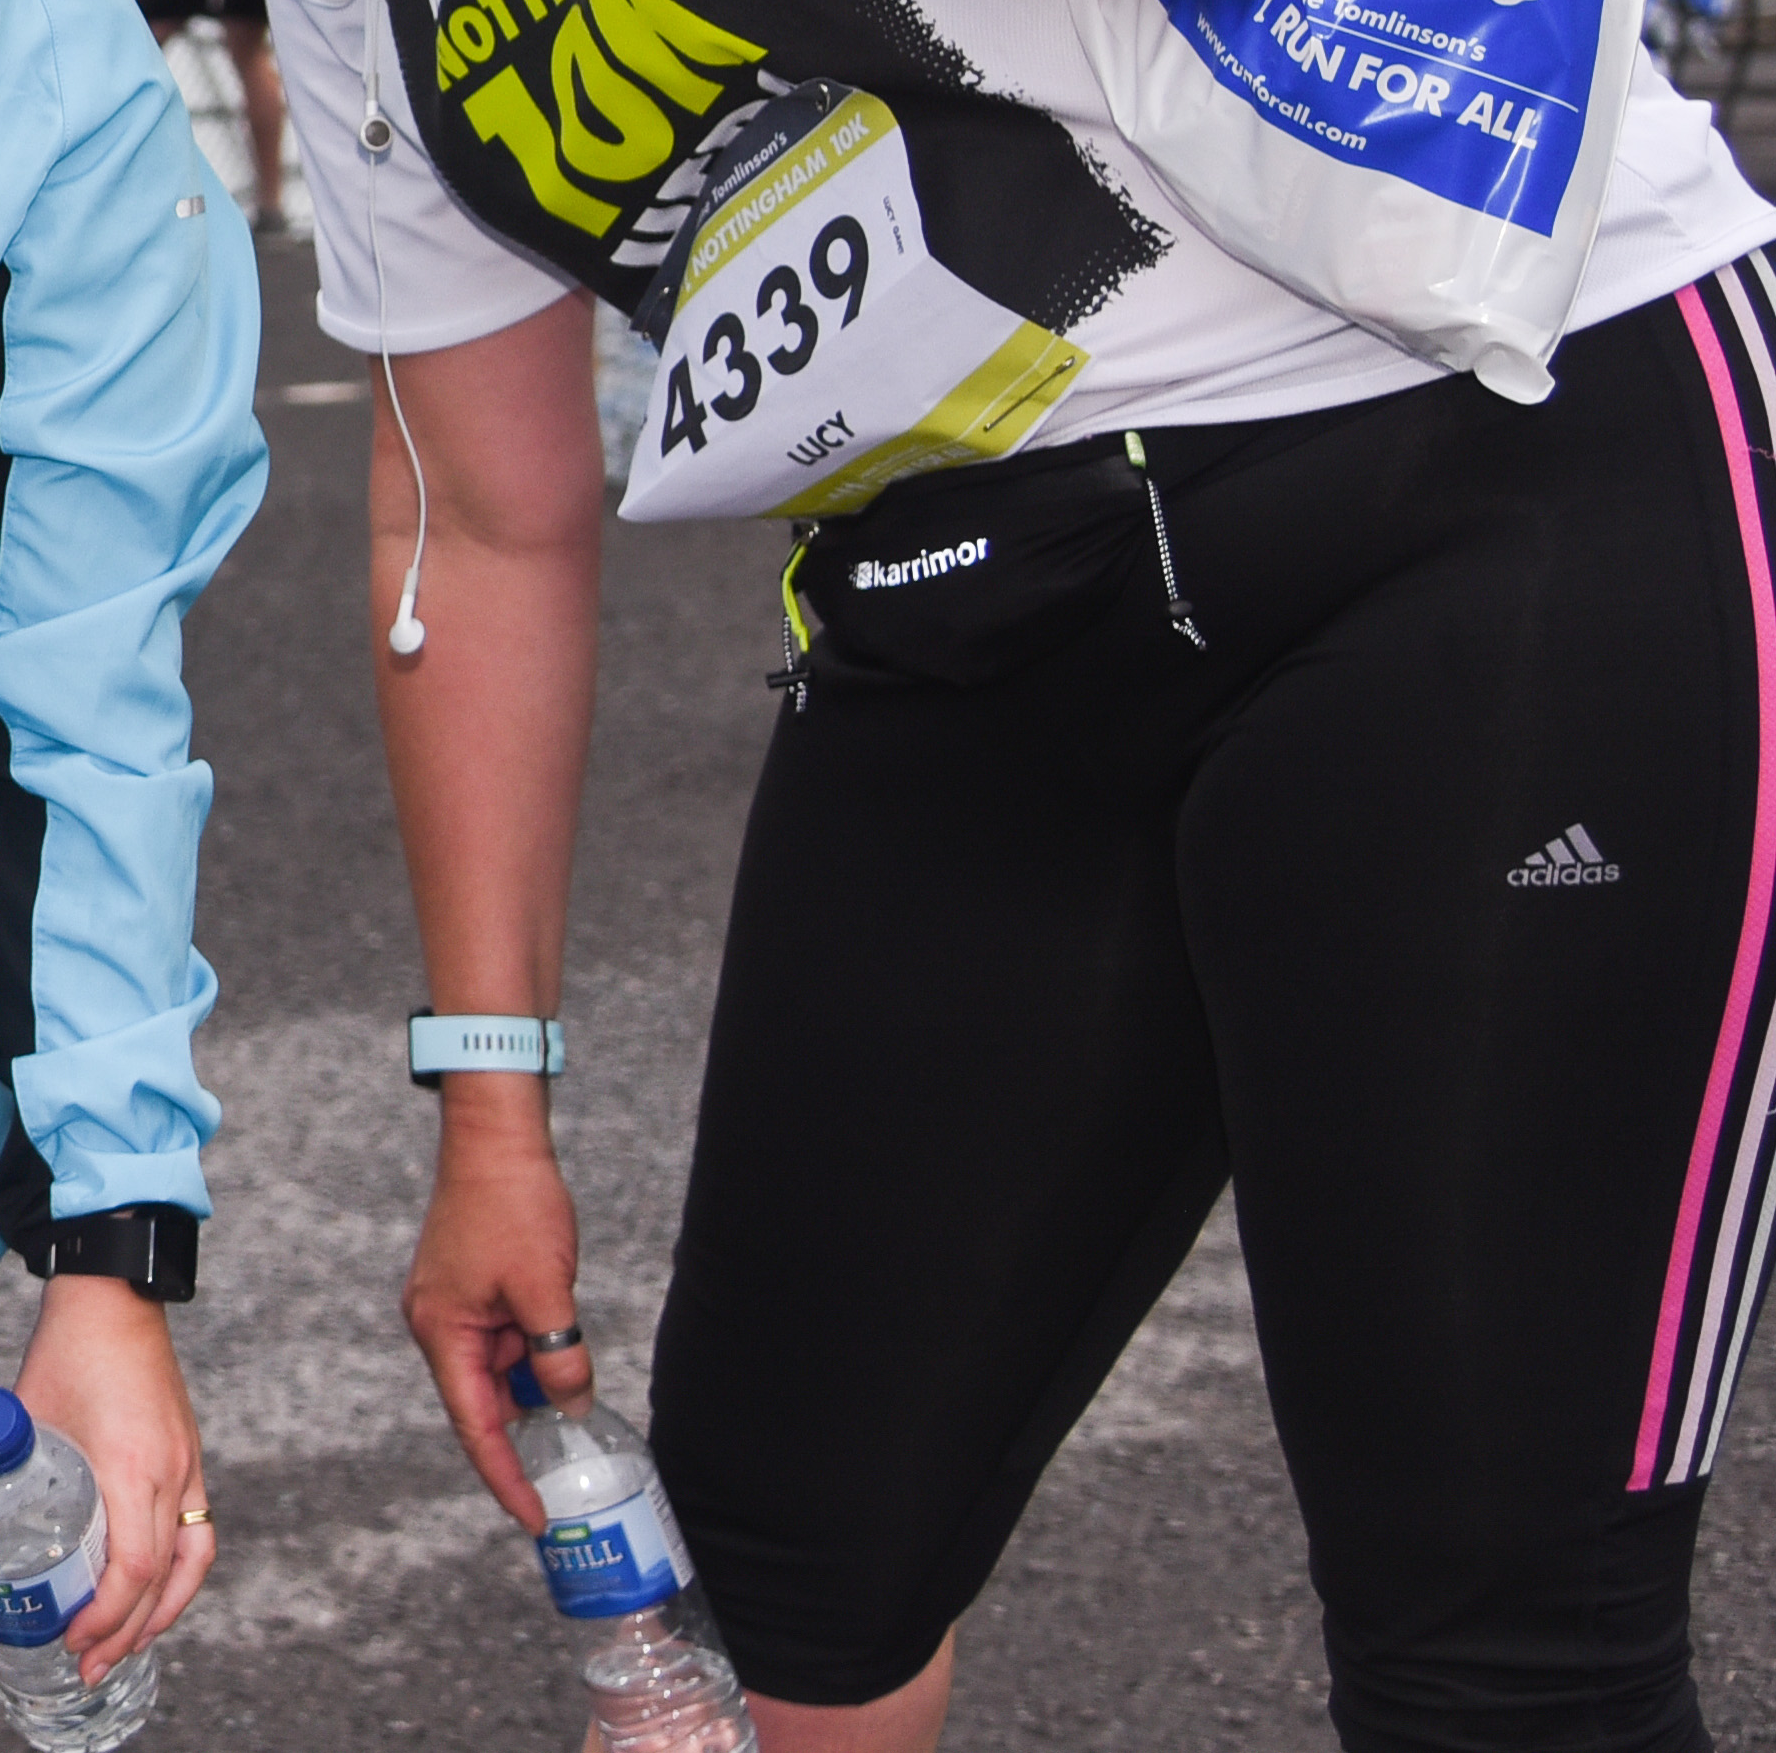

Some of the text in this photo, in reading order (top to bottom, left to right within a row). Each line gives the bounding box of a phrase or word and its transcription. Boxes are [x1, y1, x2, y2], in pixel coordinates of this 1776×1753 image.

[1270, 3, 1538, 151] RUN FOR ALL
[691, 111, 870, 277] NOTTINGHAM 10K
[711, 131, 788, 204] Tomlinson's
[883, 195, 895, 222] LUCY
[660, 214, 870, 460] 4339
[786, 409, 857, 467] LUCY
[873, 537, 988, 588] karrimor
[1507, 862, 1620, 886] adidas
[544, 1540, 623, 1572] STILL
